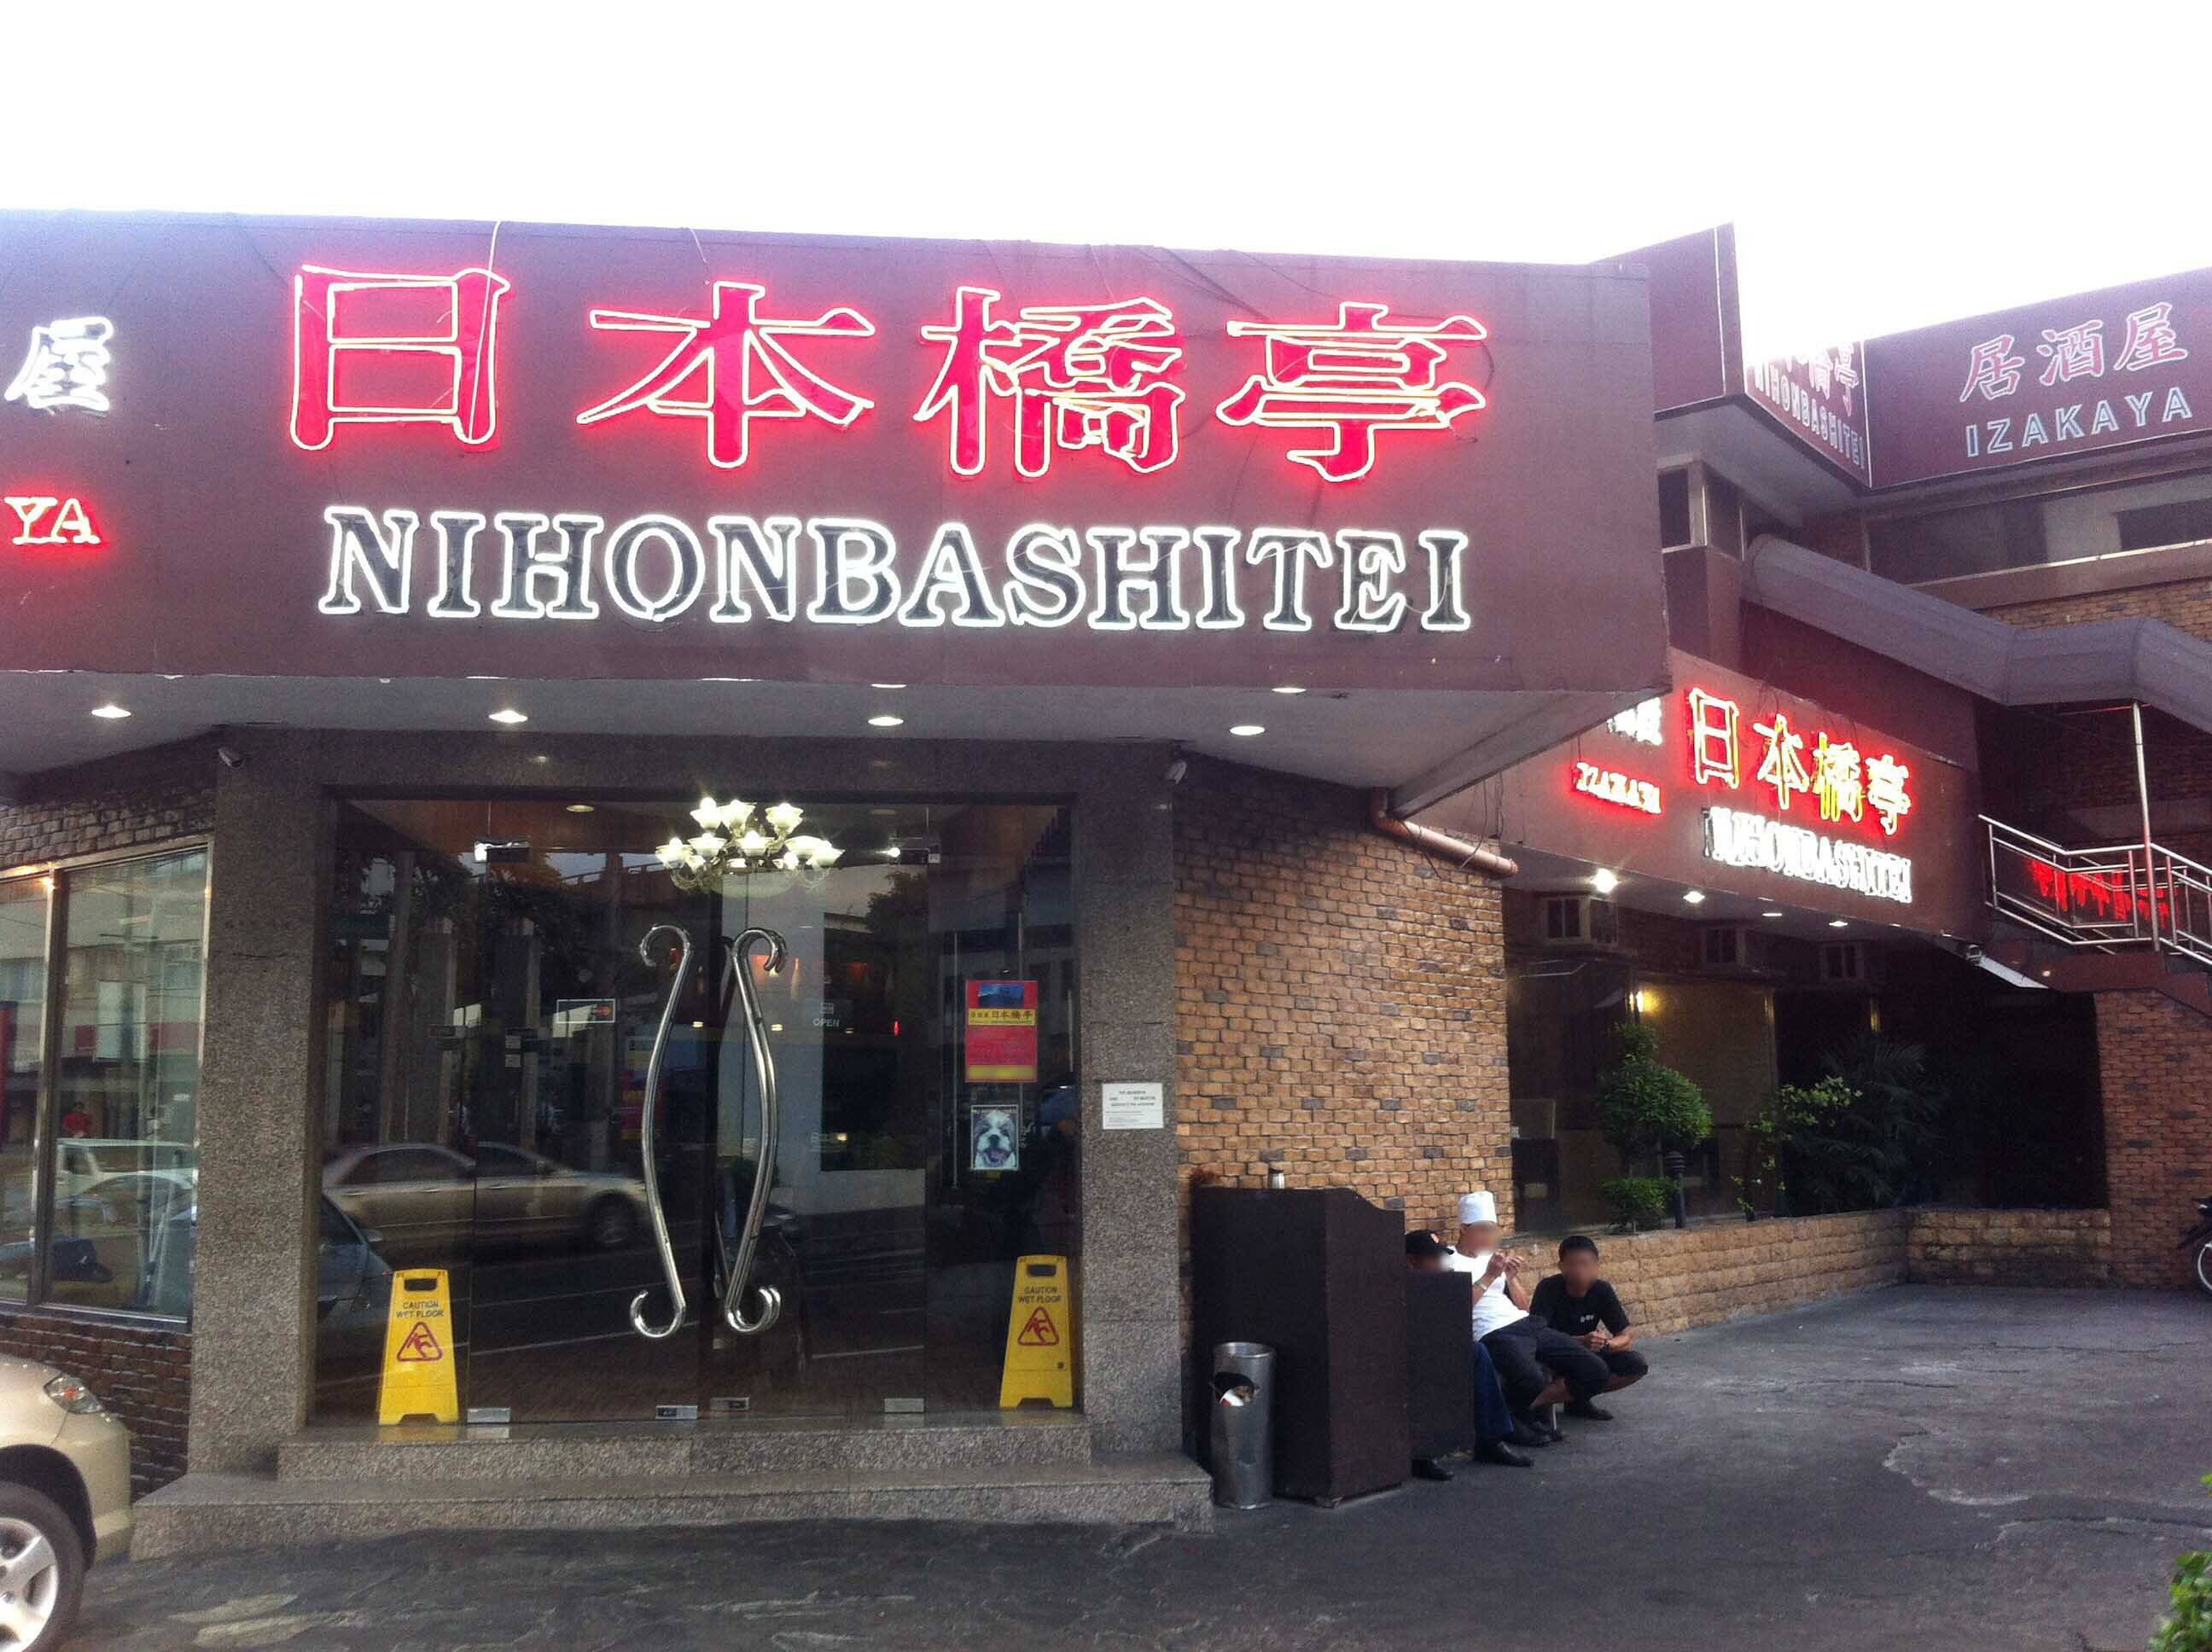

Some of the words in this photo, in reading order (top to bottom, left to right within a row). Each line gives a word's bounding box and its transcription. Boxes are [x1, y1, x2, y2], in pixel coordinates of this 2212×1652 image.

[290, 265, 1487, 483] 日本橋亭
[1960, 301, 2189, 404] 居酒屋
[1966, 387, 2192, 457] IZAKAYA
[4, 496, 101, 545] YA
[318, 505, 1471, 634] NIHONBASHITEI
[1686, 687, 1912, 836] 日本橋亭
[396, 1310, 414, 1318] WET
[403, 1301, 439, 1310] CAUTION
